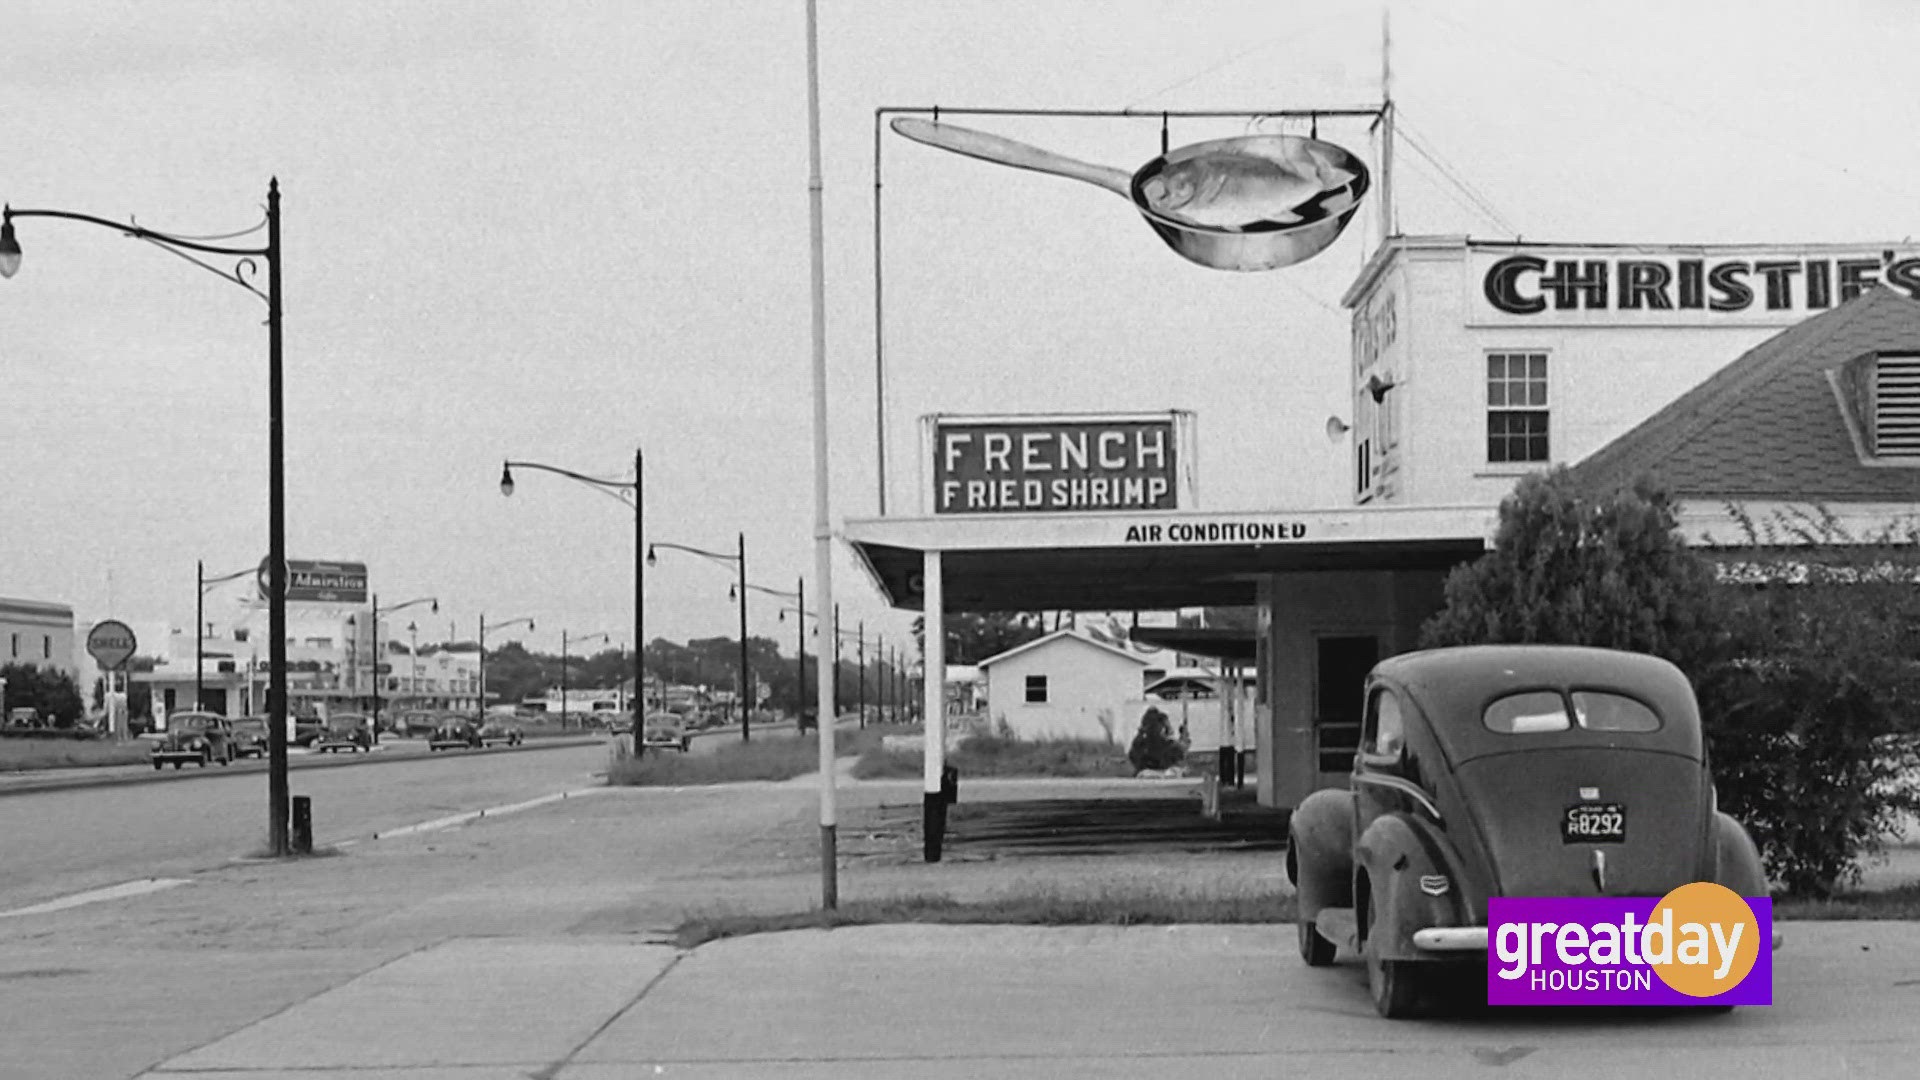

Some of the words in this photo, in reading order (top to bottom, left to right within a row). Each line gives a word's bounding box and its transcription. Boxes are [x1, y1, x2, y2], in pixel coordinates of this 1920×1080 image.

[945, 431, 1166, 472] FRENCH
[943, 479, 1043, 508] FRIED
[1051, 477, 1168, 506] SHRIMP
[1125, 525, 1163, 542] AIR
[1168, 523, 1307, 542] CONDITIONED
[92, 637, 131, 650] SHELL
[1579, 813, 1623, 834] 8292
